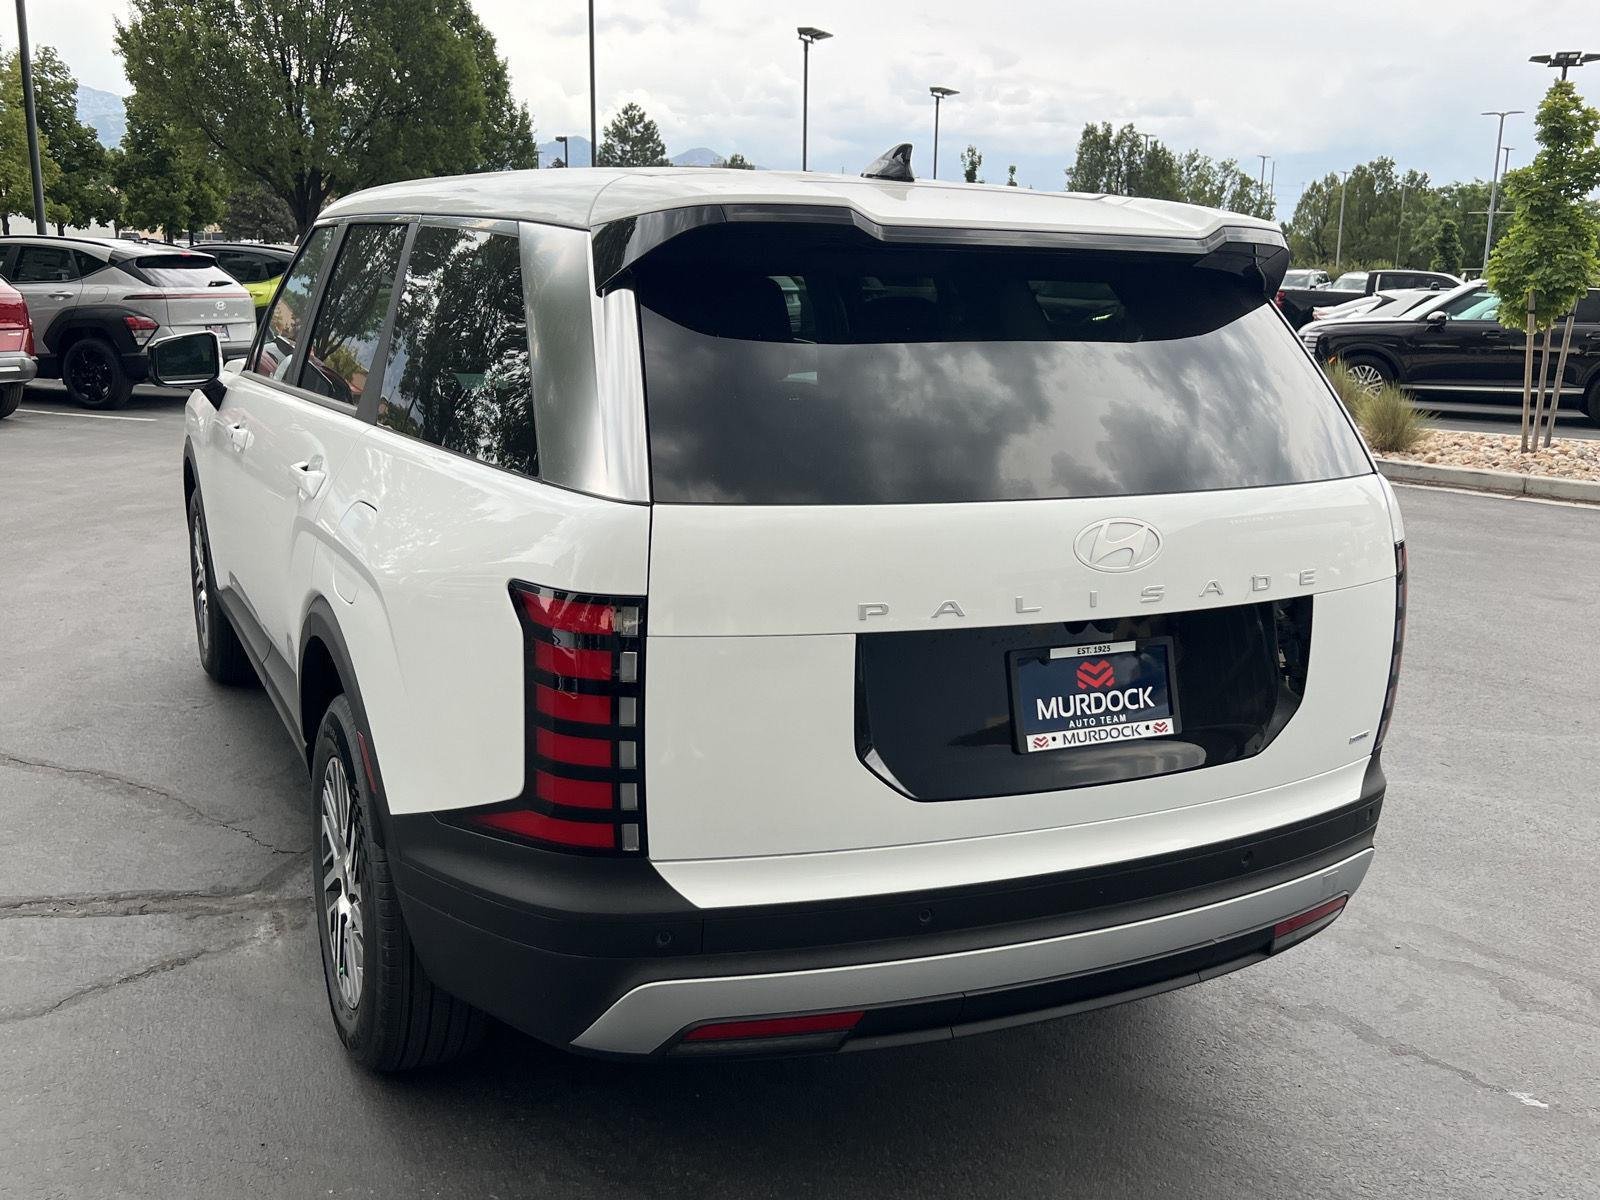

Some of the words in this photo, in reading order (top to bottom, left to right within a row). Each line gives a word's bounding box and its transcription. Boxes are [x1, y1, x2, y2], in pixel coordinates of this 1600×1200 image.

[857, 568, 1316, 620] PALISADE
[1077, 647, 1092, 655] EST.
[1093, 645, 1111, 653] 1925
[1036, 686, 1155, 720] MURDOCK
[1069, 717, 1096, 728] AUTO
[1100, 713, 1127, 725] TEAM
[1062, 724, 1142, 745] MURDOCK
